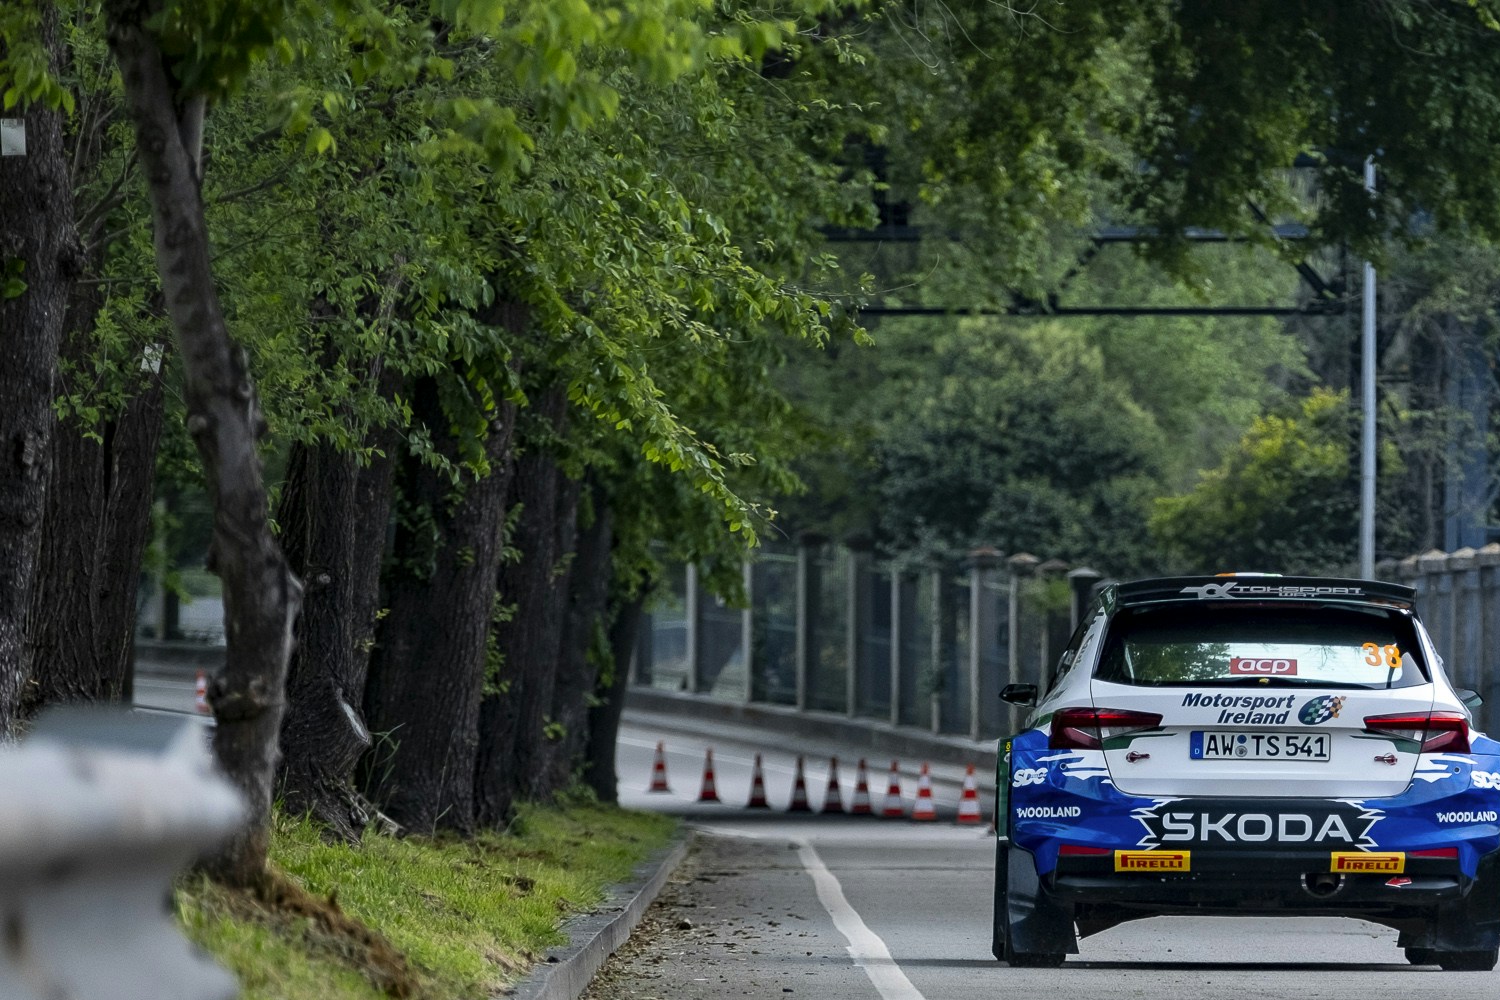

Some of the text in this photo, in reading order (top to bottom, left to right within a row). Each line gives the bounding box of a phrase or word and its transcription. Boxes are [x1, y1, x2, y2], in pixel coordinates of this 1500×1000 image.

[1362, 642, 1403, 669] 38
[1237, 659, 1291, 674] acp
[1181, 692, 1296, 711] Motorsport
[1217, 709, 1290, 725] Ireland
[1205, 734, 1328, 758] AW TS 541
[1016, 806, 1081, 818] WOODLAND
[1436, 811, 1498, 823] WOODLAND
[1120, 854, 1183, 868] PIRELLI
[1337, 856, 1400, 871] PIRELLI
